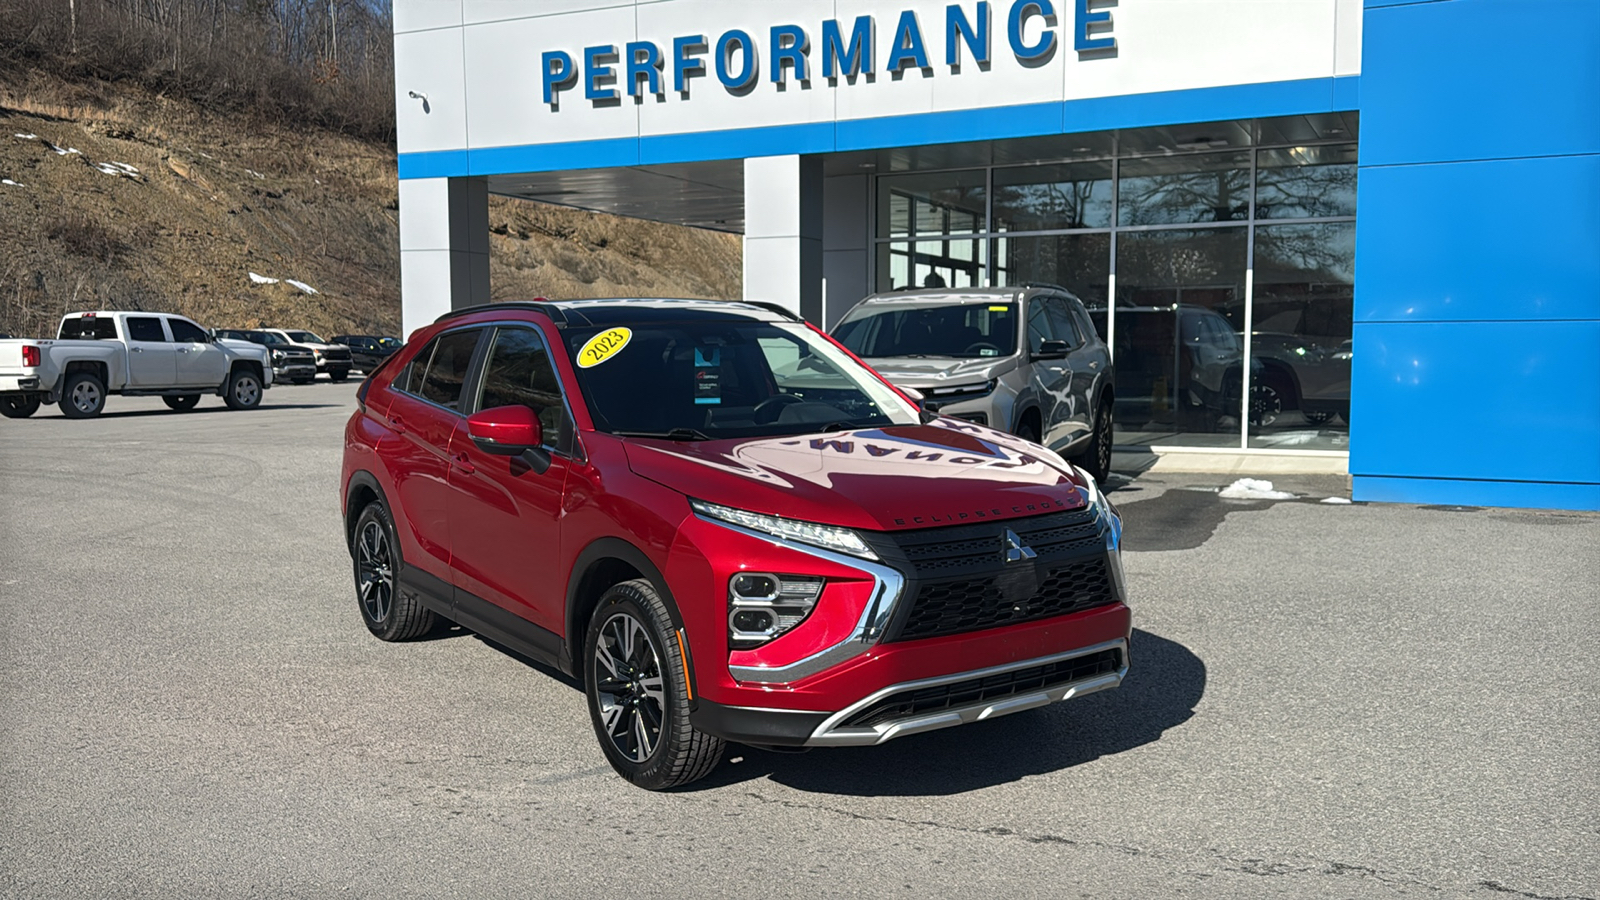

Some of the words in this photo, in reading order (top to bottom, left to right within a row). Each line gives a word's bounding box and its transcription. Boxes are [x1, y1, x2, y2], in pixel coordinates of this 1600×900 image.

[541, 0, 1117, 104] PERFORMANCE
[587, 331, 624, 361] 2023
[895, 508, 1002, 526] ECLIPSE
[1012, 497, 1076, 513] CROSS
